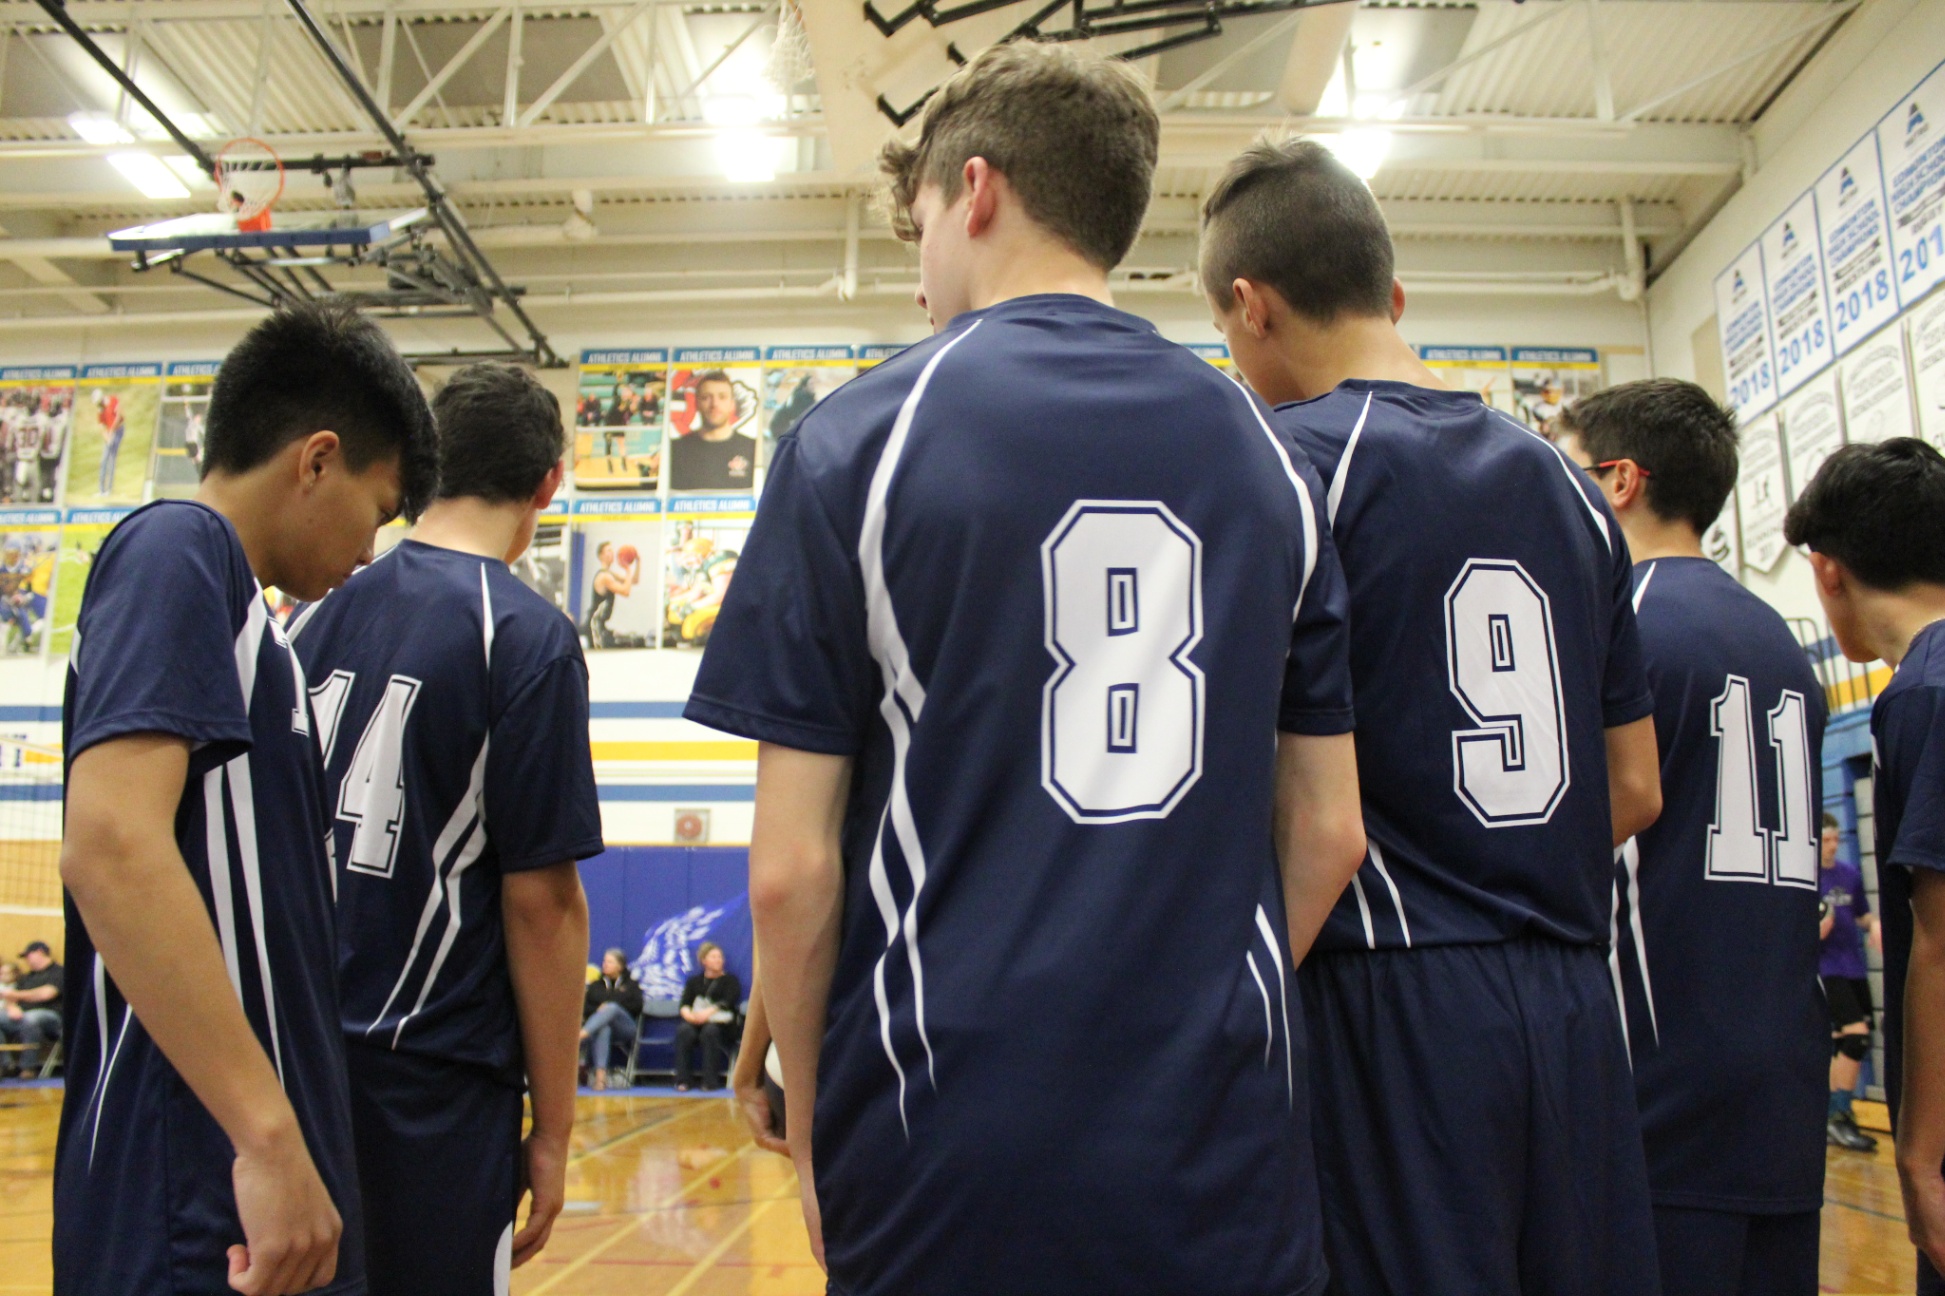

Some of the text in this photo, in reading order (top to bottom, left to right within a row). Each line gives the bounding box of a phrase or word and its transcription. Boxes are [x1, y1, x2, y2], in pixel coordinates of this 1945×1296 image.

[1900, 222, 1944, 283] 201
[1836, 269, 1889, 333] 2018
[587, 351, 662, 364] ATHLETICS ALUMNI
[679, 349, 755, 362] ATHLETICS ALUMNI
[771, 348, 848, 360] ATHLETICS ALUMNI
[1779, 319, 1825, 375] 2018
[1730, 361, 1770, 410] 2018
[71, 512, 112, 524] ATHLETICS
[580, 501, 655, 513] ATHLETICS ALUMNI
[673, 499, 750, 512] ATHLETICS ALUMNI
[1041, 499, 1205, 824] 8
[1444, 558, 1570, 829] 9
[1704, 673, 1818, 891] 11
